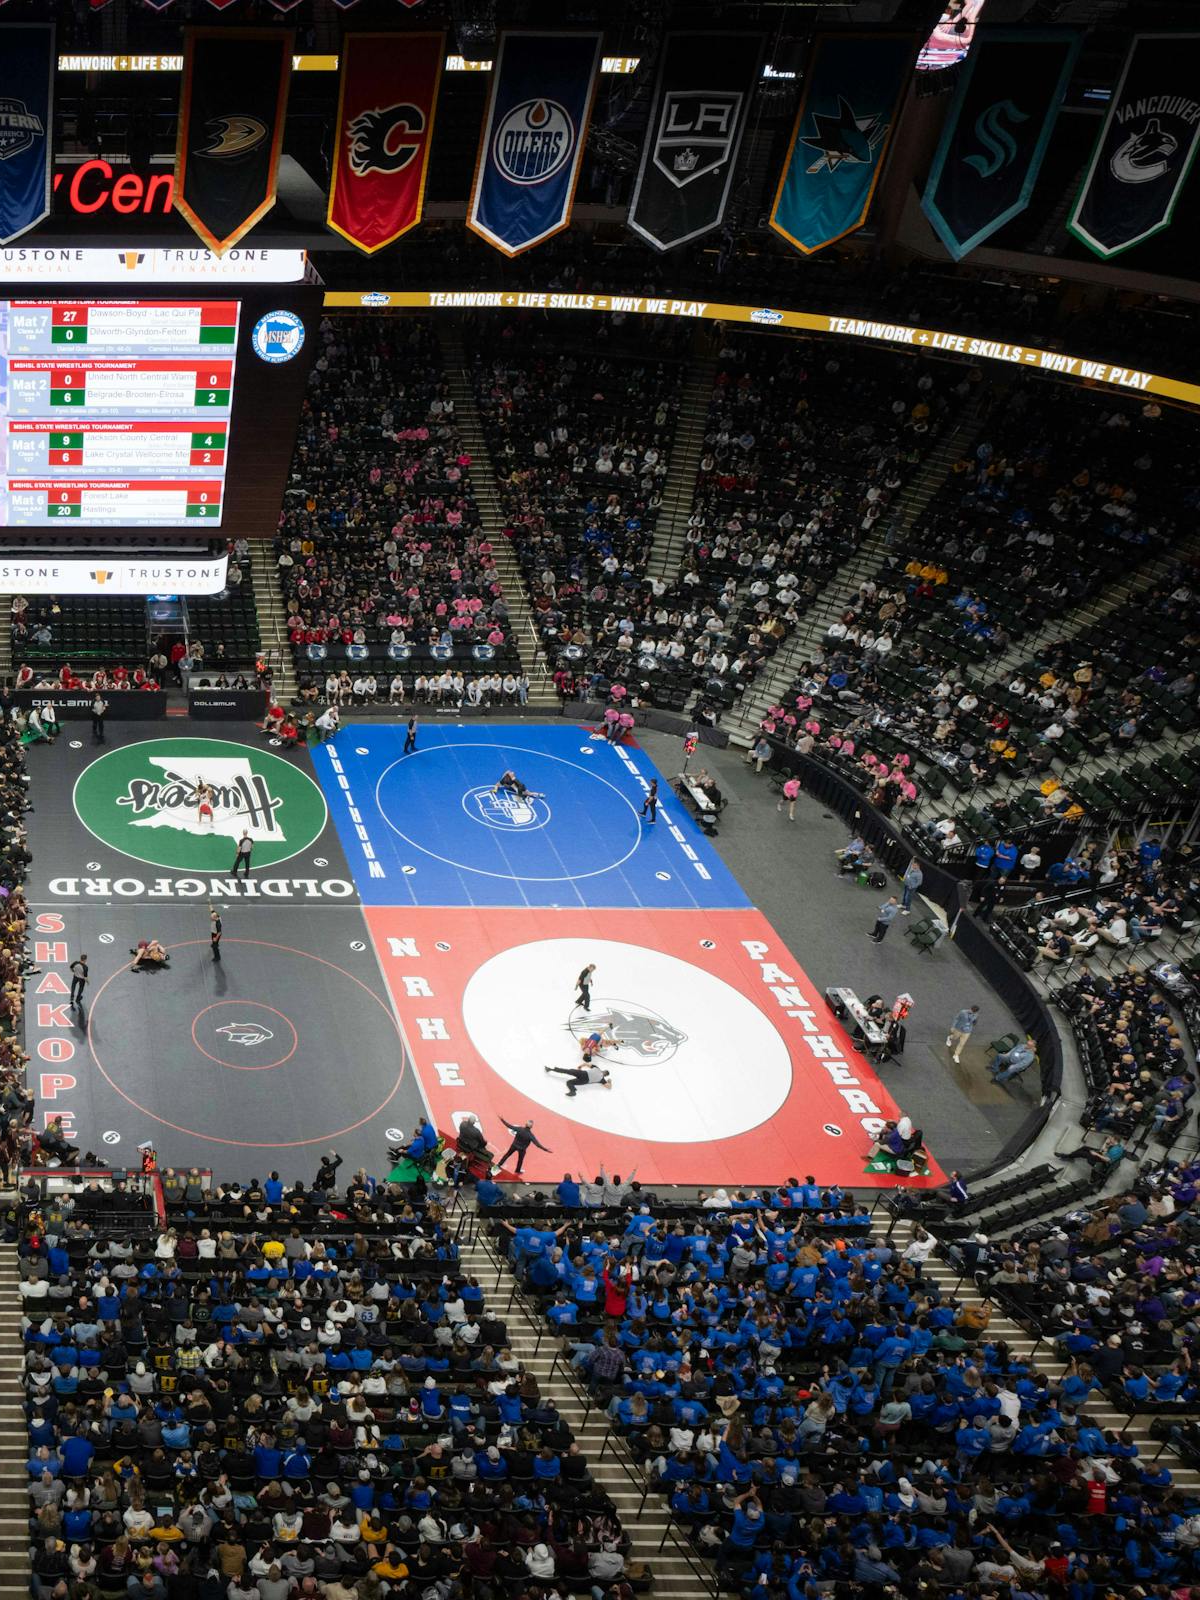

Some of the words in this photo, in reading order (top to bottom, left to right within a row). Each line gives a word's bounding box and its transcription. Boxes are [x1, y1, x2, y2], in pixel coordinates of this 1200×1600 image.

[131, 56, 157, 70] LIFE
[1116, 95, 1200, 125] VANCOUVER
[666, 103, 732, 132] LA
[504, 130, 563, 153] OILERS
[70, 159, 174, 214] Cen
[430, 293, 503, 306] TEAMWORK
[518, 294, 546, 307] LIFE
[549, 294, 595, 310] SKILLS
[611, 297, 643, 312] WHY
[646, 299, 668, 314] WE
[670, 301, 708, 317] PLAY
[14, 316, 40, 327] Mat
[42, 316, 48, 327] 7
[62, 312, 76, 322] 27
[66, 330, 74, 340] 0
[828, 317, 915, 344] TEAMWORK
[931, 333, 966, 353] LIFE
[968, 339, 1023, 362] SKILLS
[1040, 351, 1079, 374] WHY
[1080, 360, 1107, 380] WE
[1108, 366, 1153, 390] PLAY
[64, 376, 72, 385] 0
[88, 373, 114, 381] United
[116, 373, 140, 381] North
[142, 373, 170, 381] Central
[210, 376, 217, 385] 0
[13, 380, 40, 391] Mat
[40, 380, 47, 391] 2
[64, 393, 72, 402] 6
[208, 394, 216, 403] 2
[62, 436, 70, 446] 9
[119, 434, 148, 443] County
[204, 436, 212, 446] 4
[12, 440, 38, 450] Mat
[38, 440, 46, 450] 4
[62, 453, 70, 462] 6
[85, 450, 104, 458] Lake
[106, 450, 133, 460] Crystal
[203, 453, 211, 462] 2
[12, 495, 37, 506] Mat
[37, 495, 44, 506] 6
[61, 493, 68, 502] 0
[200, 493, 208, 502] 0
[58, 506, 71, 516] 20
[200, 506, 207, 516] 3
[128, 568, 220, 578] TRUSTONE
[325, 744, 386, 879] WARRIORS
[48, 877, 360, 897] OLDINGFORD
